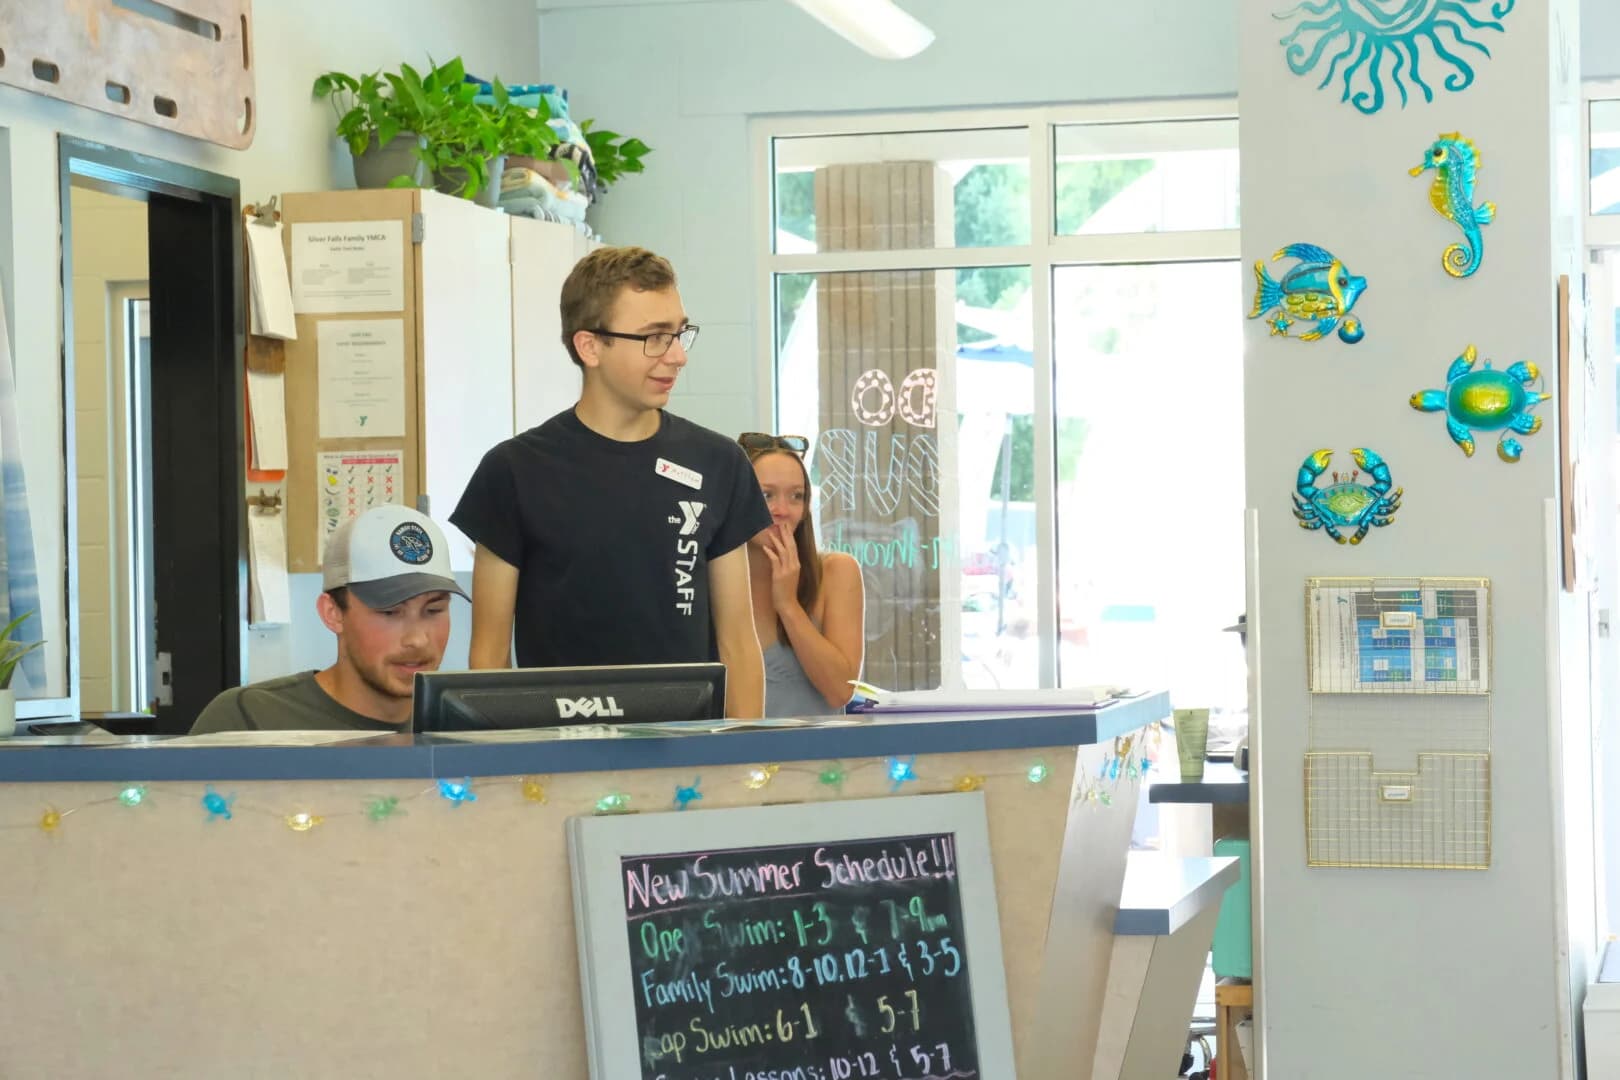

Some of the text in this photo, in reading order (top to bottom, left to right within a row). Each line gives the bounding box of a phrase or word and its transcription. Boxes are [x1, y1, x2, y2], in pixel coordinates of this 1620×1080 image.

[674, 538, 698, 616] STAFF
[556, 696, 624, 719] DELL
[627, 863, 689, 909] New
[694, 856, 803, 899] Summer
[641, 922, 700, 961] Ope
[793, 902, 832, 947] 1-3
[641, 969, 714, 1013] Family
[716, 962, 788, 998] Swim:
[917, 937, 961, 977] 3-5
[690, 1017, 772, 1053] Swim:
[776, 1002, 818, 1042] 6-1
[877, 989, 920, 1033] 5-7
[910, 1043, 950, 1075] 5-7
